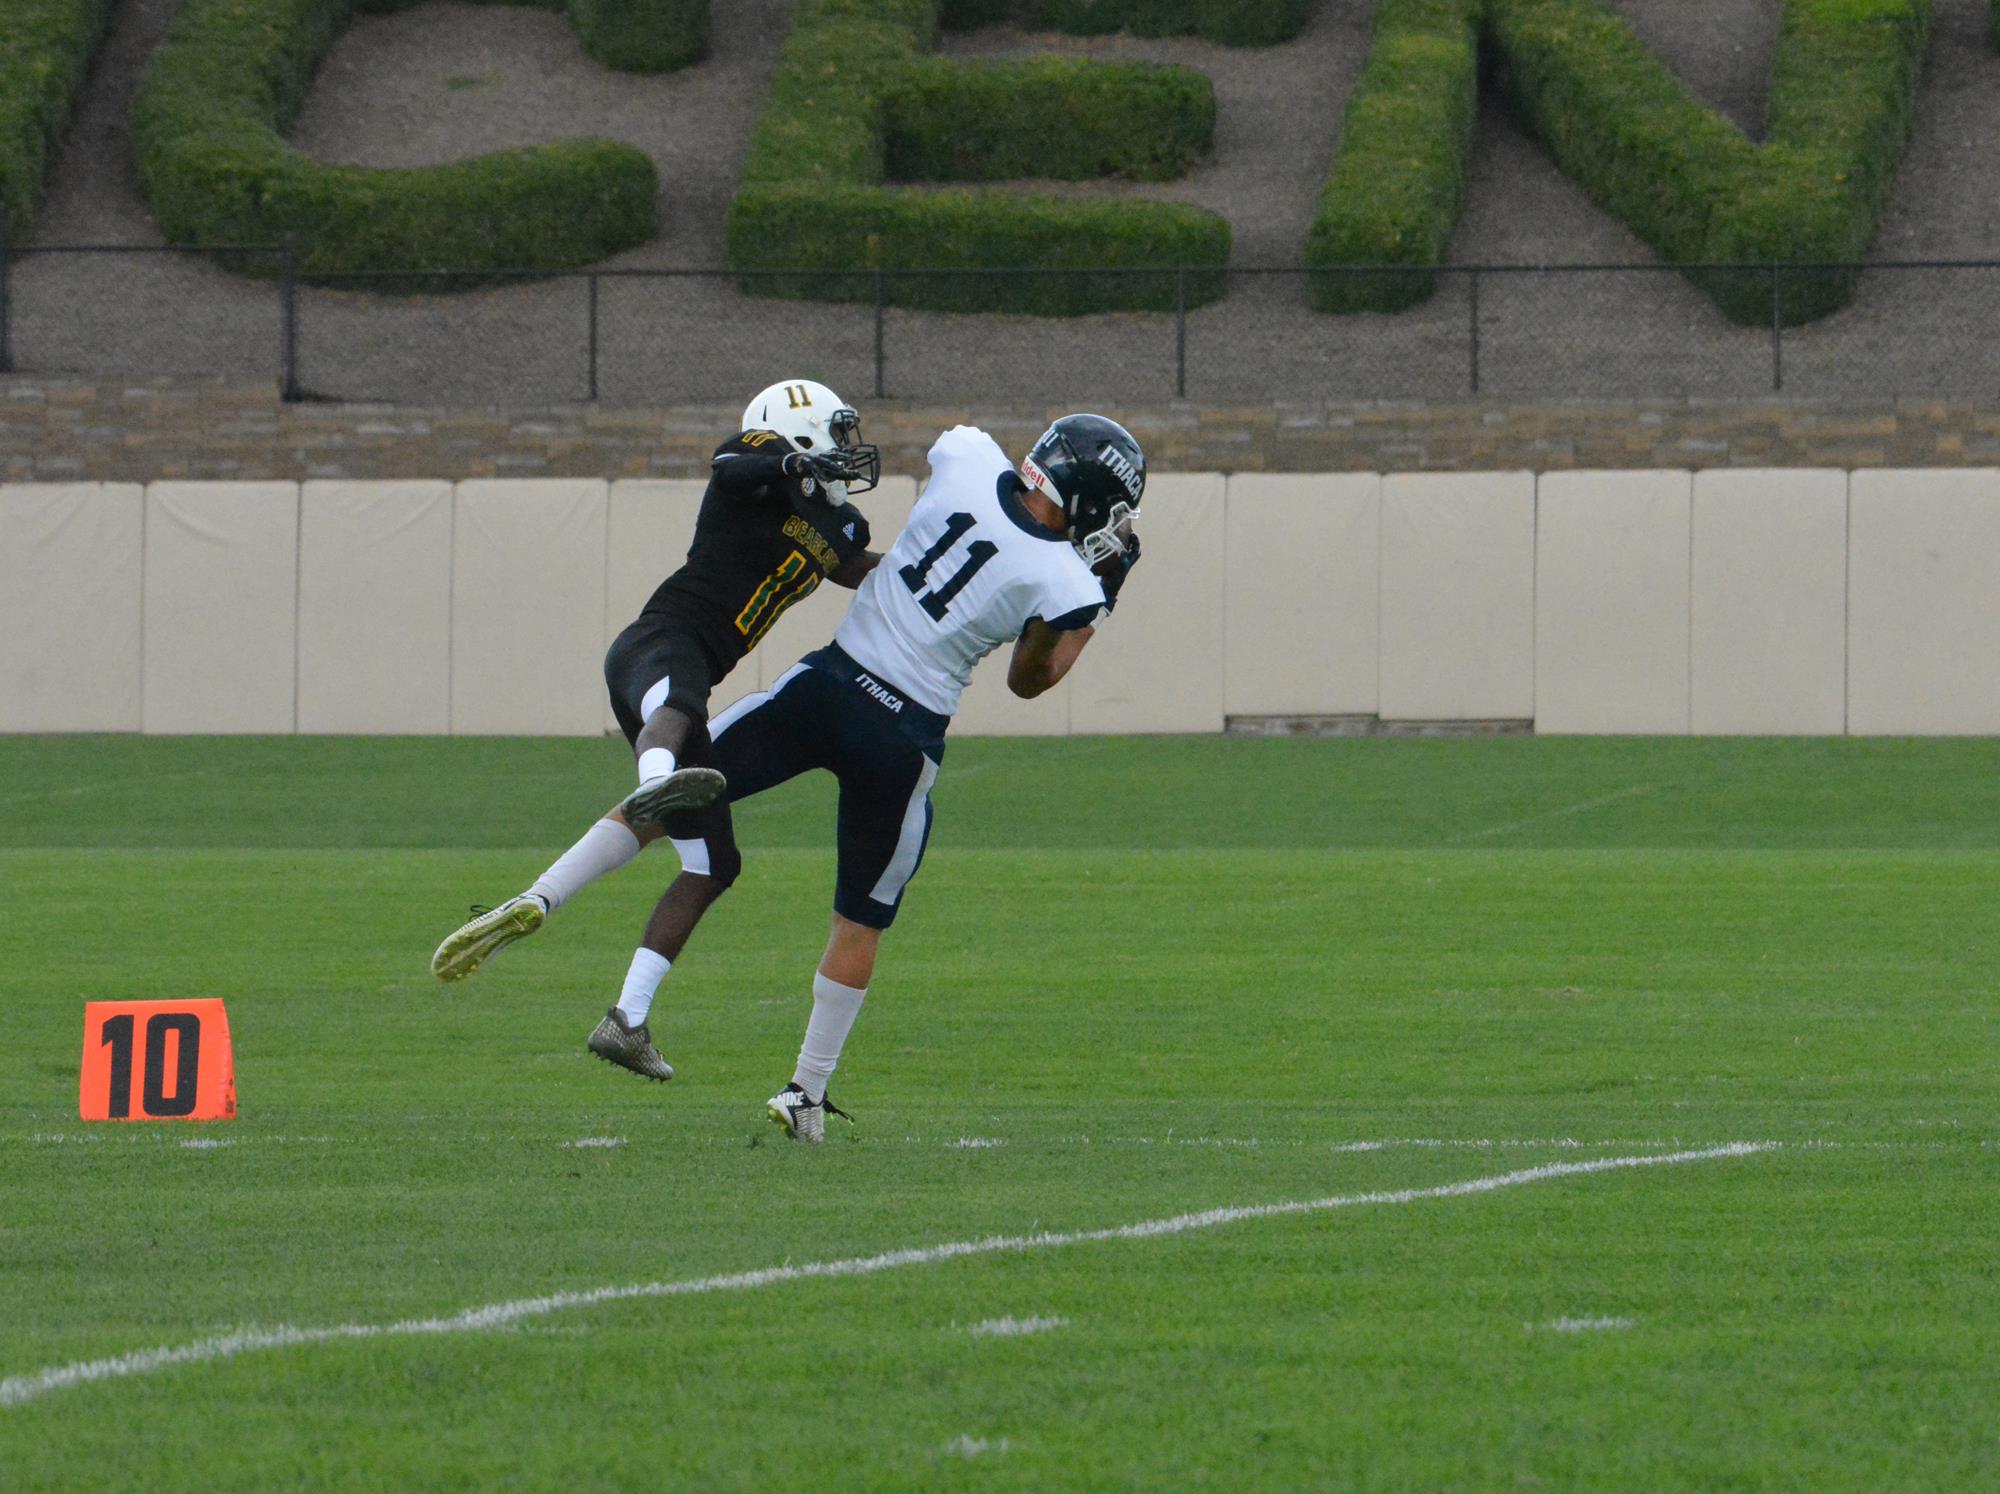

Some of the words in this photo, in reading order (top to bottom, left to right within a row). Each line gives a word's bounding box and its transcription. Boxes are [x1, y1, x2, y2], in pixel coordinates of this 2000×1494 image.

[784, 384, 813, 409] 11
[742, 430, 778, 447] 11
[1098, 444, 1143, 501] ITHACA
[782, 514, 841, 574] BEARCA
[898, 511, 999, 623] 11
[855, 672, 904, 713] ITHACA
[101, 1013, 201, 1118] 10
